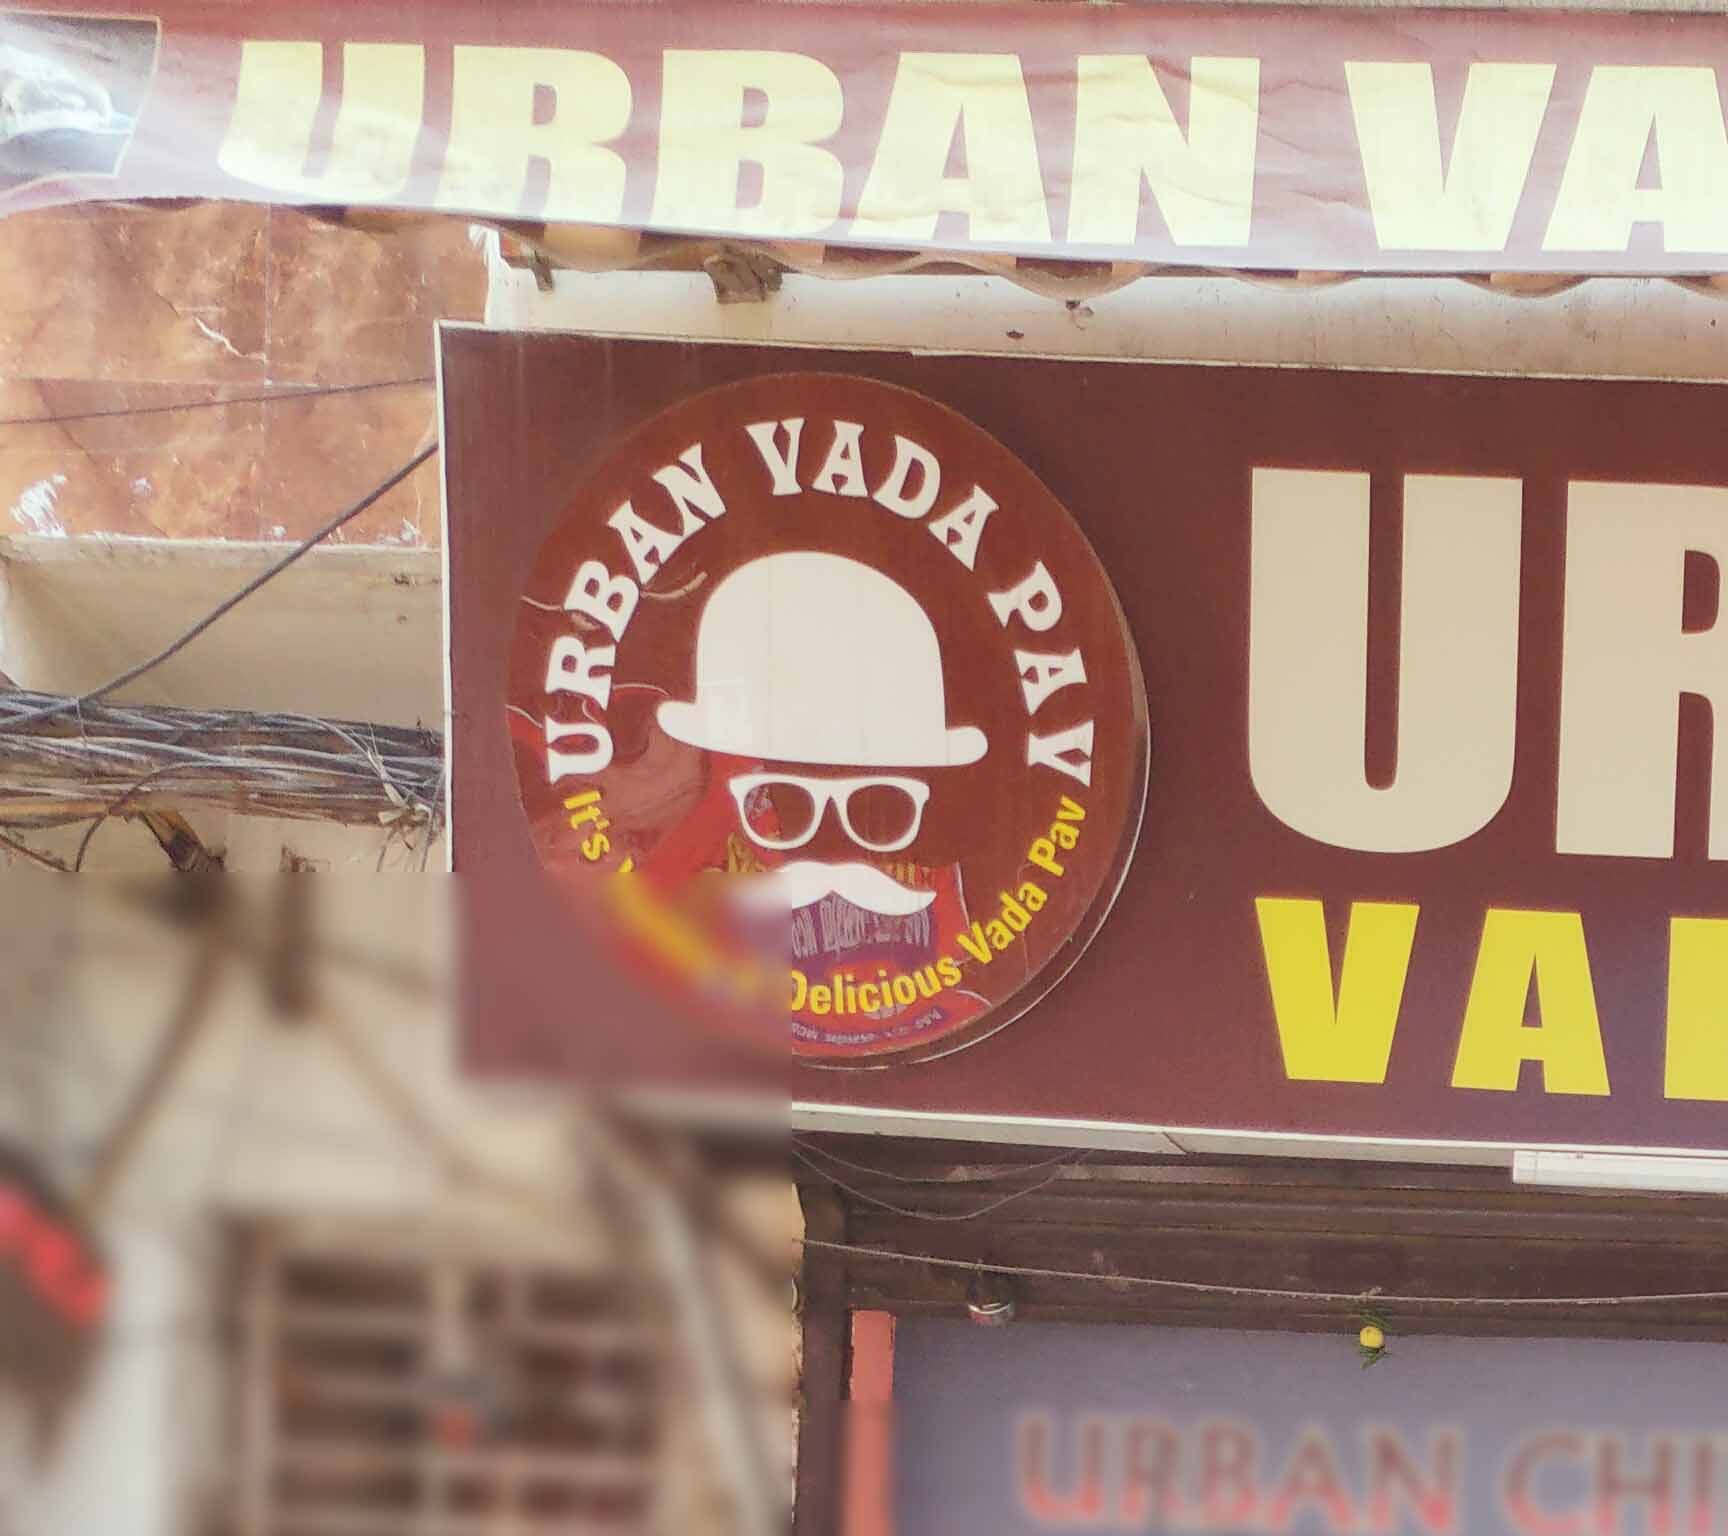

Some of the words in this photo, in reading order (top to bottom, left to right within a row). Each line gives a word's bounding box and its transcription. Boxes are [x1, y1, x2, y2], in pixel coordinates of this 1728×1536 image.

[216, 40, 1261, 248] URBAN
[543, 442, 727, 785] URBAN
[744, 417, 999, 570] VADA
[987, 561, 1095, 787] PAV
[955, 881, 1049, 965] Vada
[1027, 794, 1087, 878] Pav
